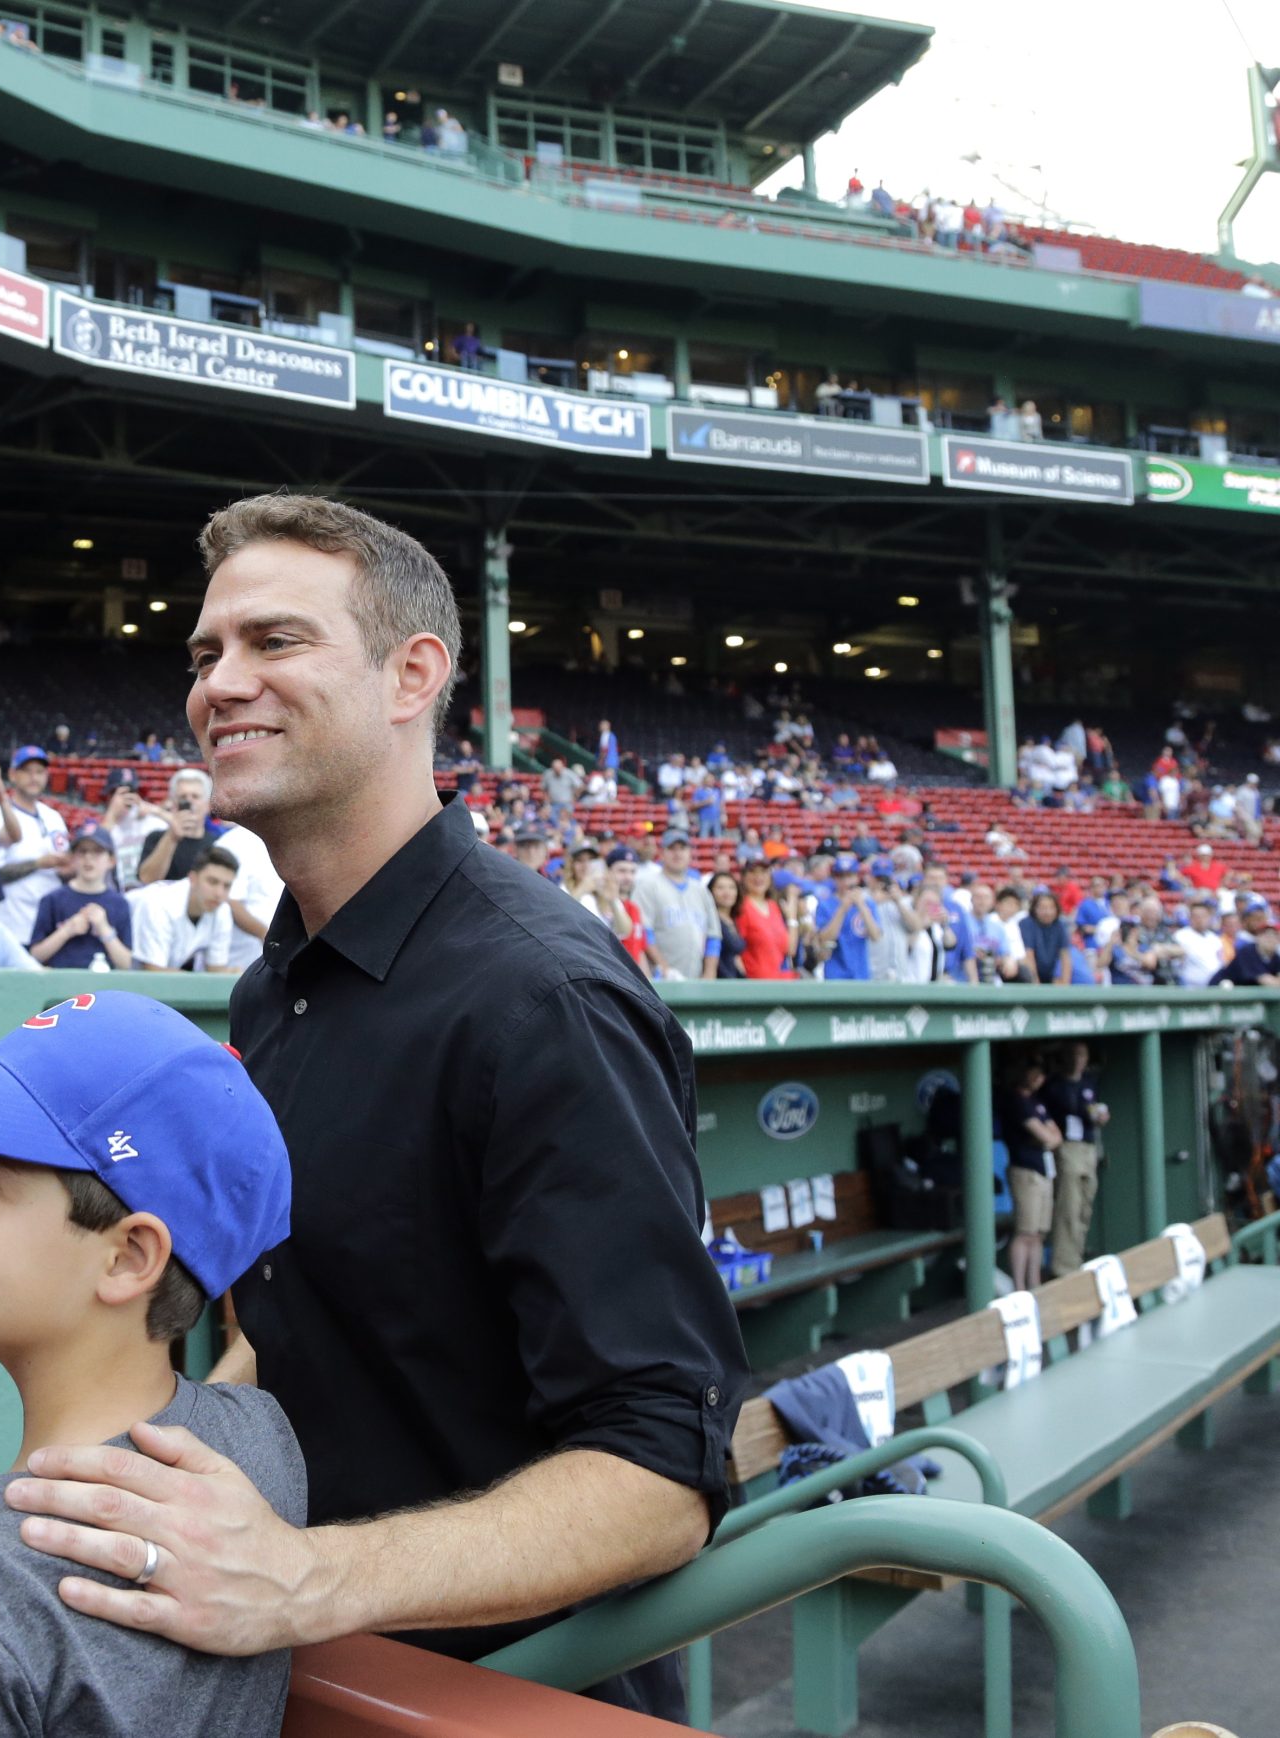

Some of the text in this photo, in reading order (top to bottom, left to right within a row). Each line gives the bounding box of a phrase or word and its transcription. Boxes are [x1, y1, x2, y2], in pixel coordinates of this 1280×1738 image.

[108, 315, 343, 378] Beth Israel Deaconess
[108, 341, 278, 388] Medical Center
[391, 368, 636, 438] COLUMBIA TECH
[710, 427, 803, 457] Barracuda
[977, 456, 1121, 490] Museum of Science
[714, 1018, 767, 1048] America
[769, 1092, 809, 1131] Ford
